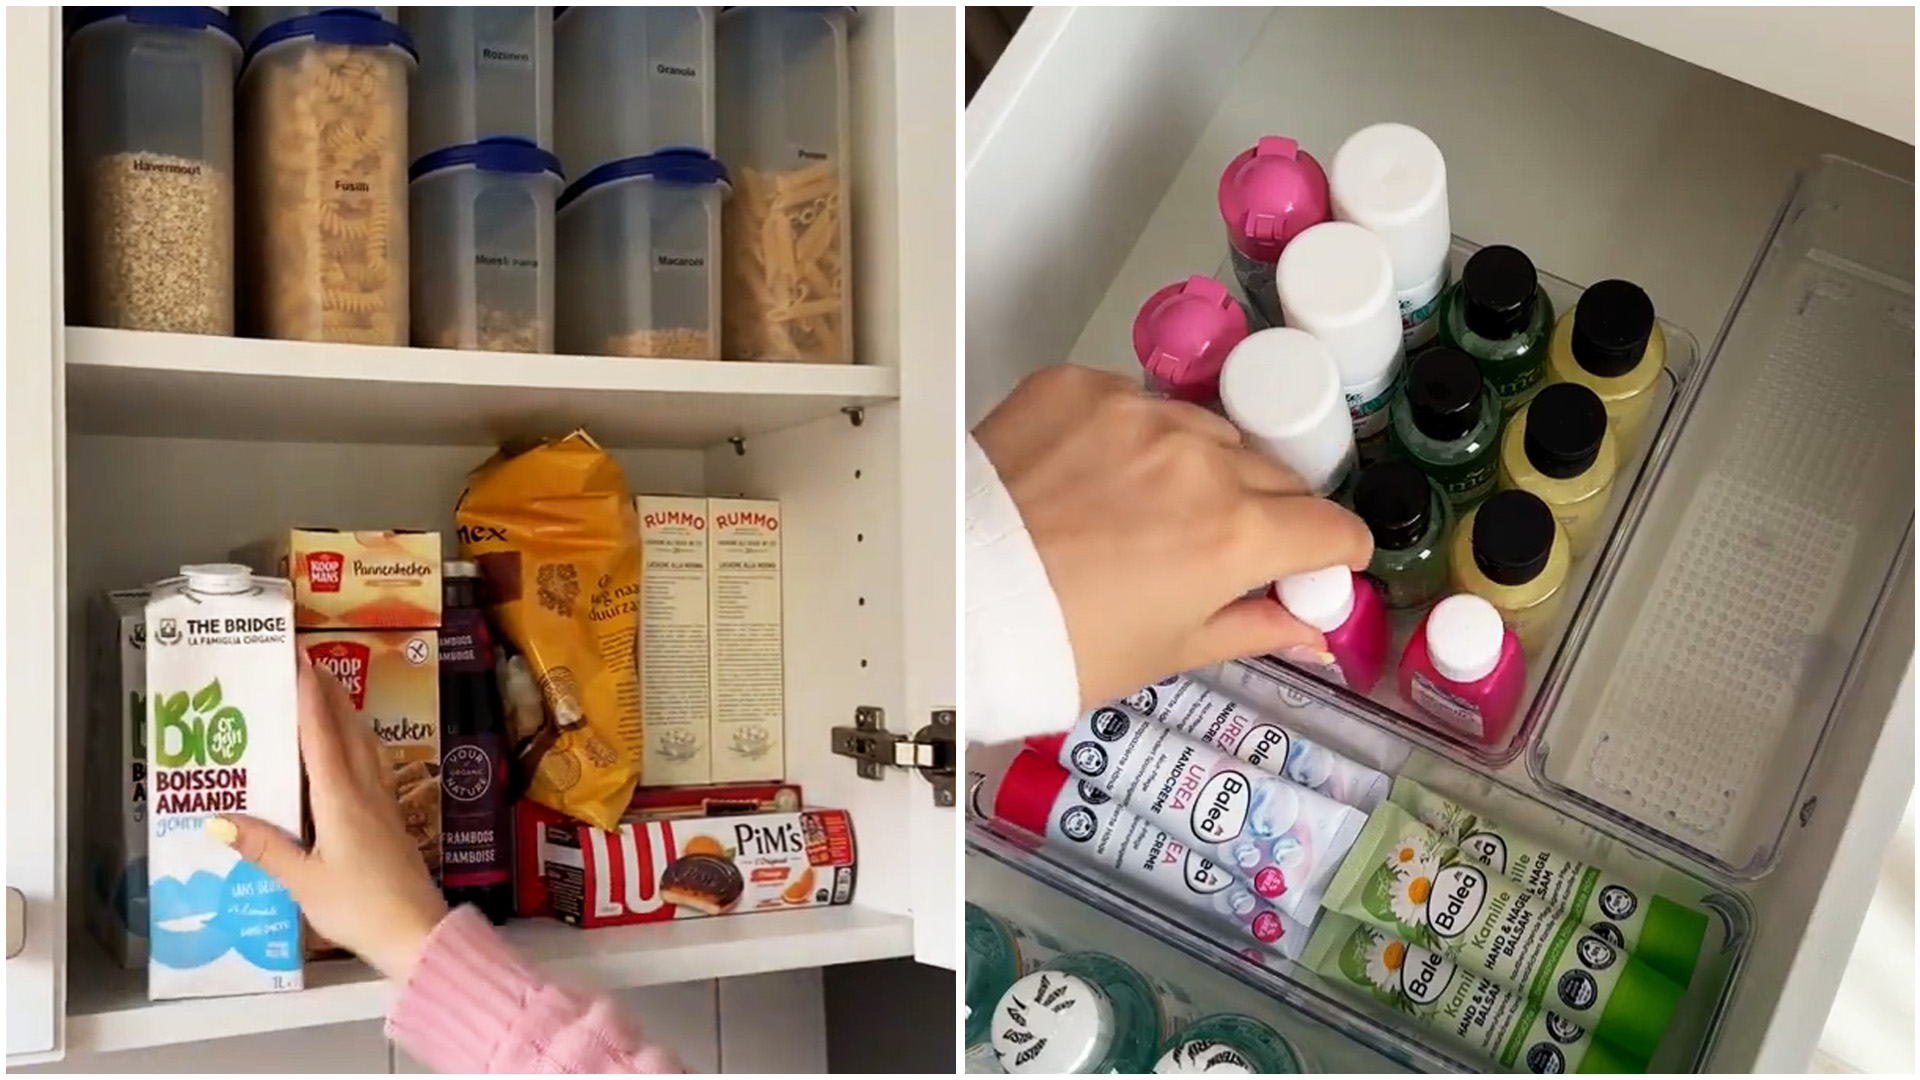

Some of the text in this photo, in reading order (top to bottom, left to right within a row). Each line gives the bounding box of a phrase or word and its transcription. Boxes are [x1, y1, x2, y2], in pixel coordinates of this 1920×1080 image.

[133, 159, 202, 176] Havermout
[334, 179, 370, 193] Fusilli
[644, 511, 705, 530] RUMMO
[716, 511, 778, 531] RUMMO
[310, 560, 340, 573] KOOP
[614, 583, 641, 599] naa
[588, 600, 640, 622] duurza
[187, 618, 286, 634] THE BRIDGE
[156, 768, 247, 792] BOISSON
[1151, 746, 1195, 814] HANDCREME
[1169, 764, 1206, 810] UREA
[156, 791, 247, 814] AMANDE
[1201, 777, 1243, 832] Balea
[1162, 842, 1183, 864] EA
[588, 821, 667, 918] LU
[1435, 874, 1477, 930] Balea
[1471, 891, 1511, 949] Kamille
[1484, 889, 1532, 970] HAND & NAGEL
[1503, 910, 1533, 957] BALSAM
[1457, 1003, 1477, 1037] HAND
